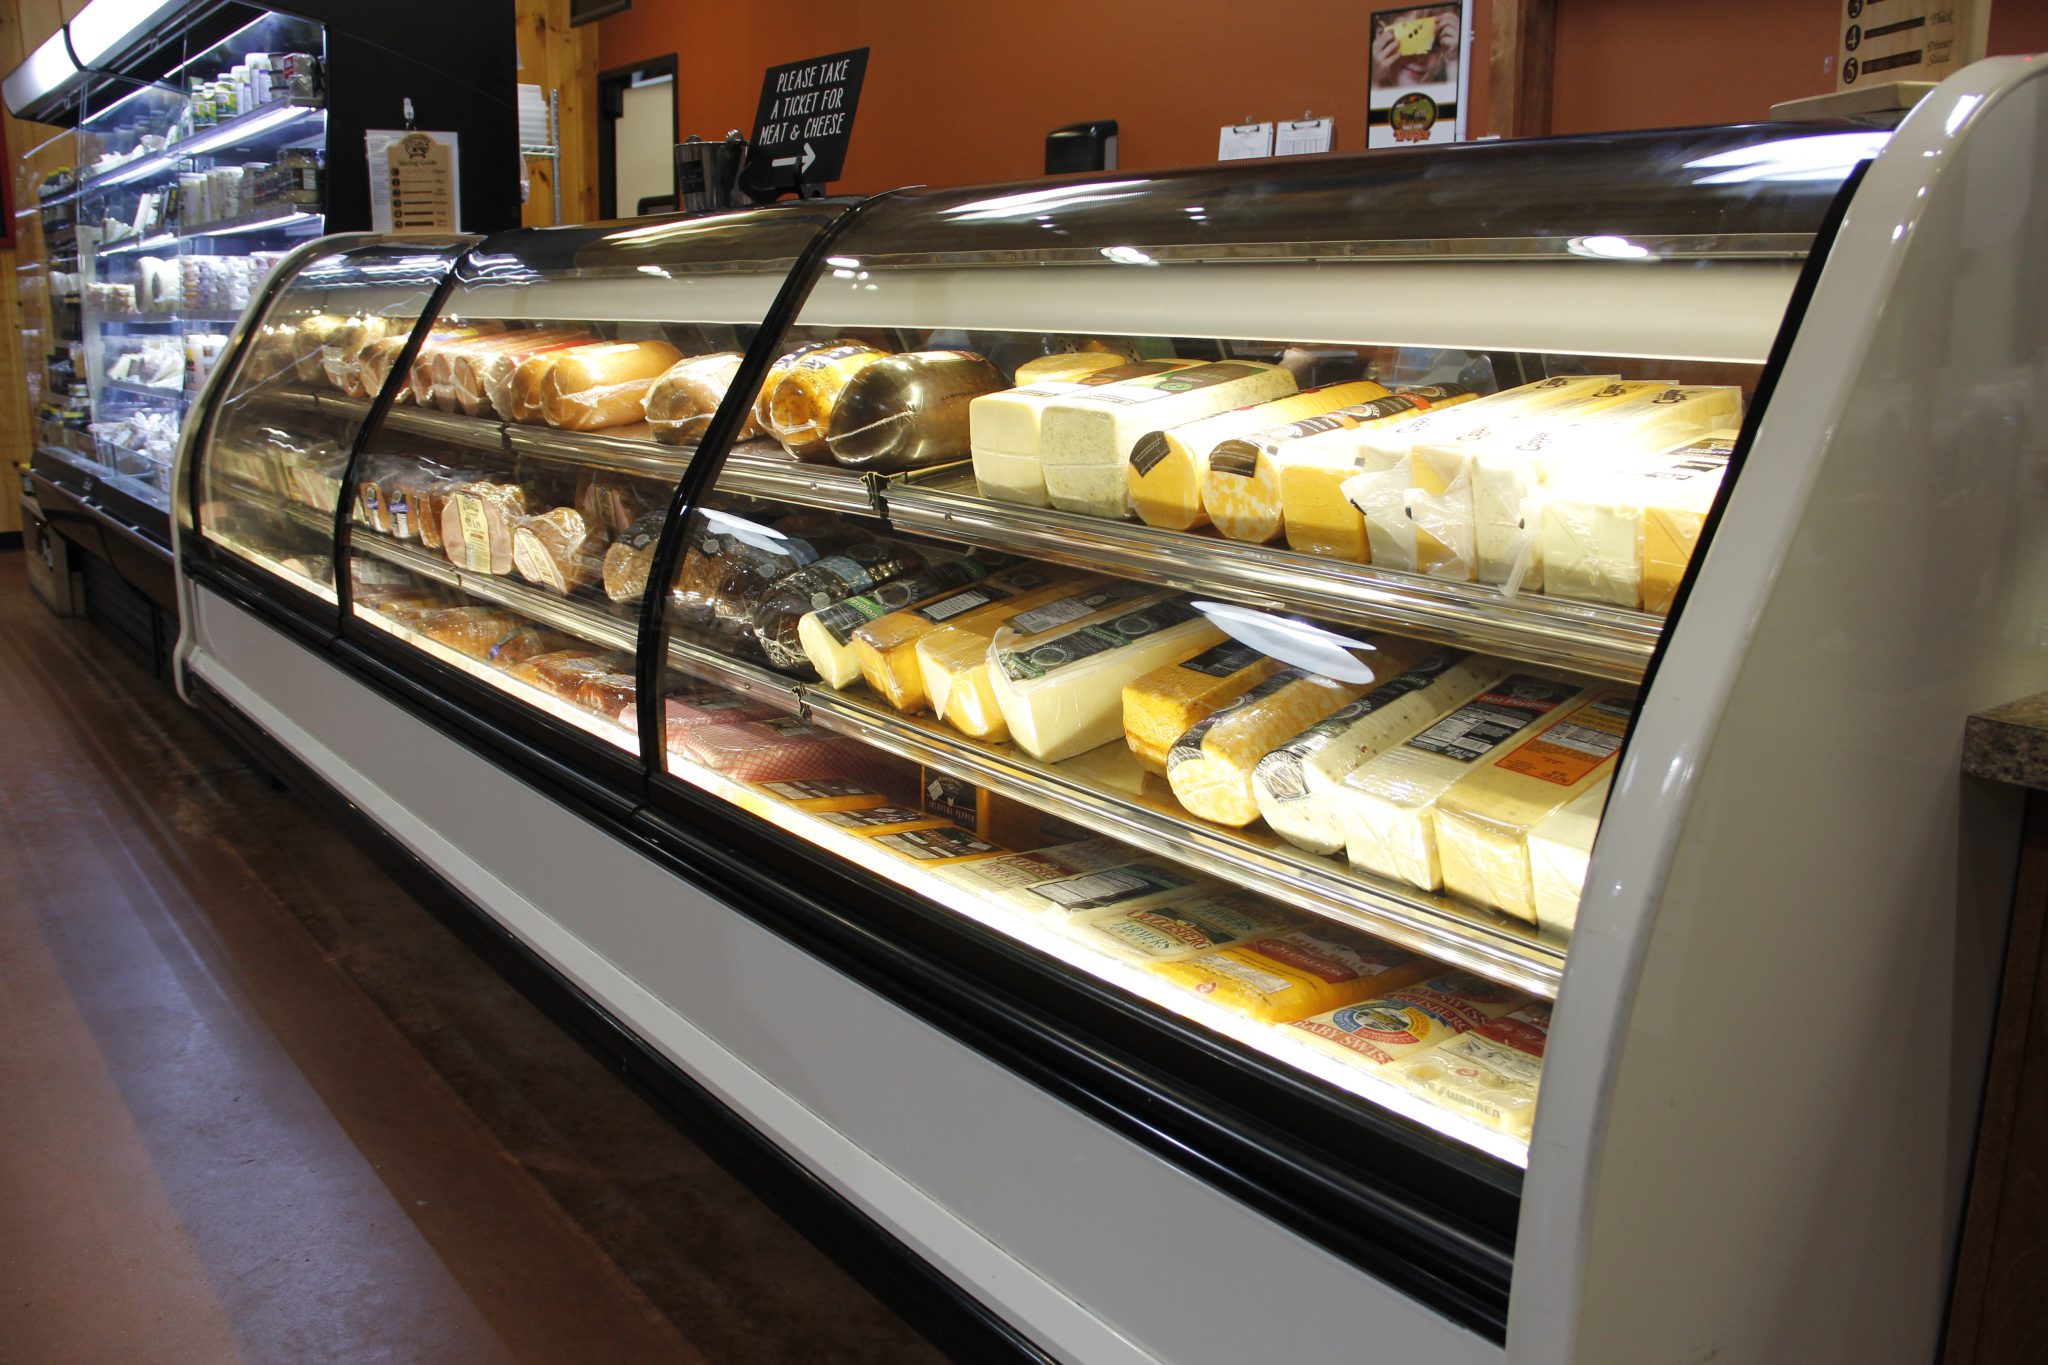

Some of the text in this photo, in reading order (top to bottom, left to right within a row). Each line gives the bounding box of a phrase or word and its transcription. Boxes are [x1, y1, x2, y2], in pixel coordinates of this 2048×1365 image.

[776, 59, 850, 93] PLEASE TAKE
[770, 87, 844, 120] A TICKET FOR
[759, 112, 846, 146] MEAT & CHEESE
